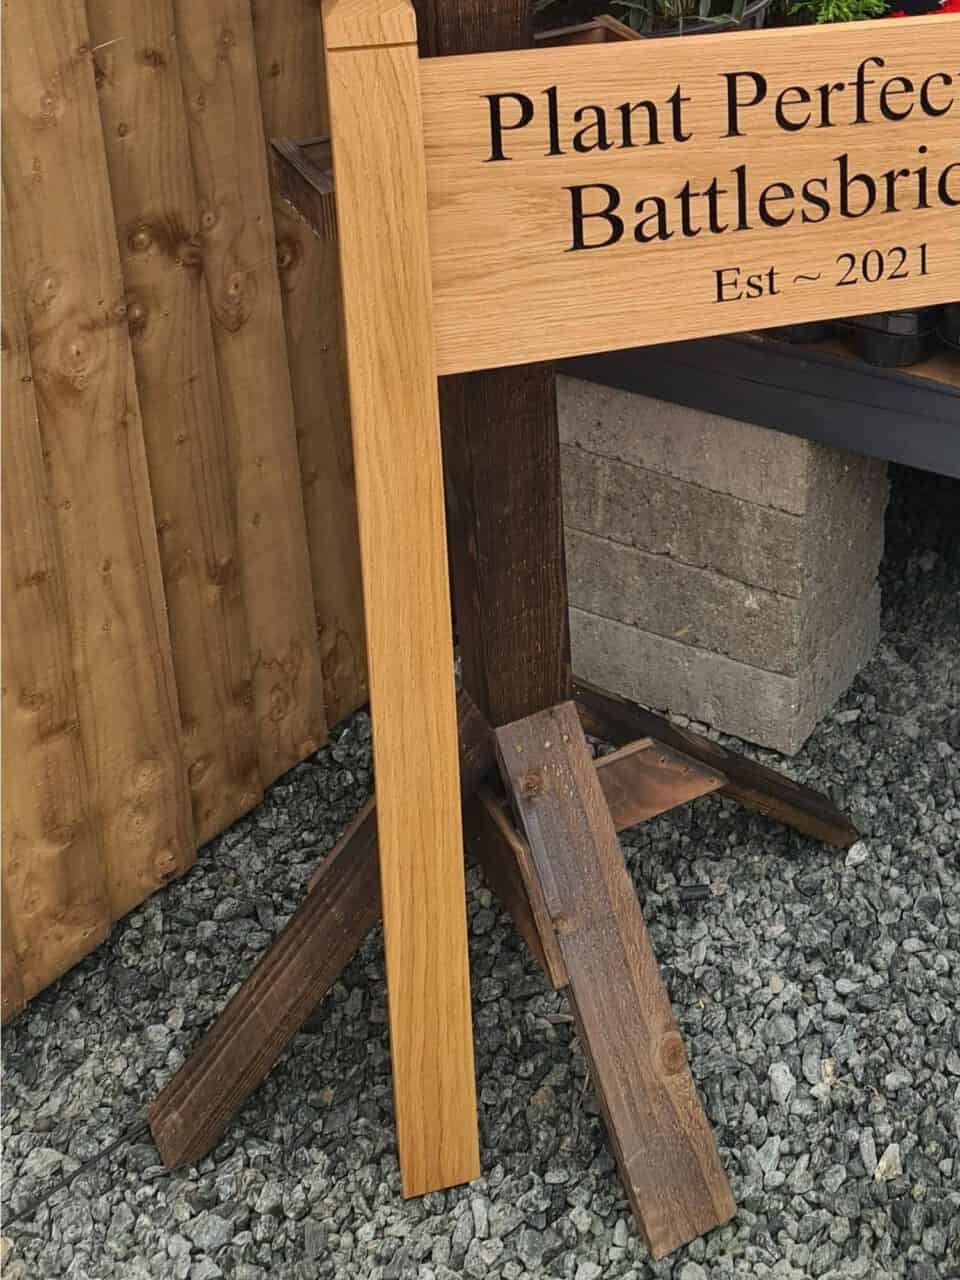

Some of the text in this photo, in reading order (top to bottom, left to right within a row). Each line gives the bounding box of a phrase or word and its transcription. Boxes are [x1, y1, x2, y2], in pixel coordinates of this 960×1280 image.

[479, 83, 694, 163] Plant
[714, 268, 781, 304] Est
[835, 242, 930, 288] 2021
